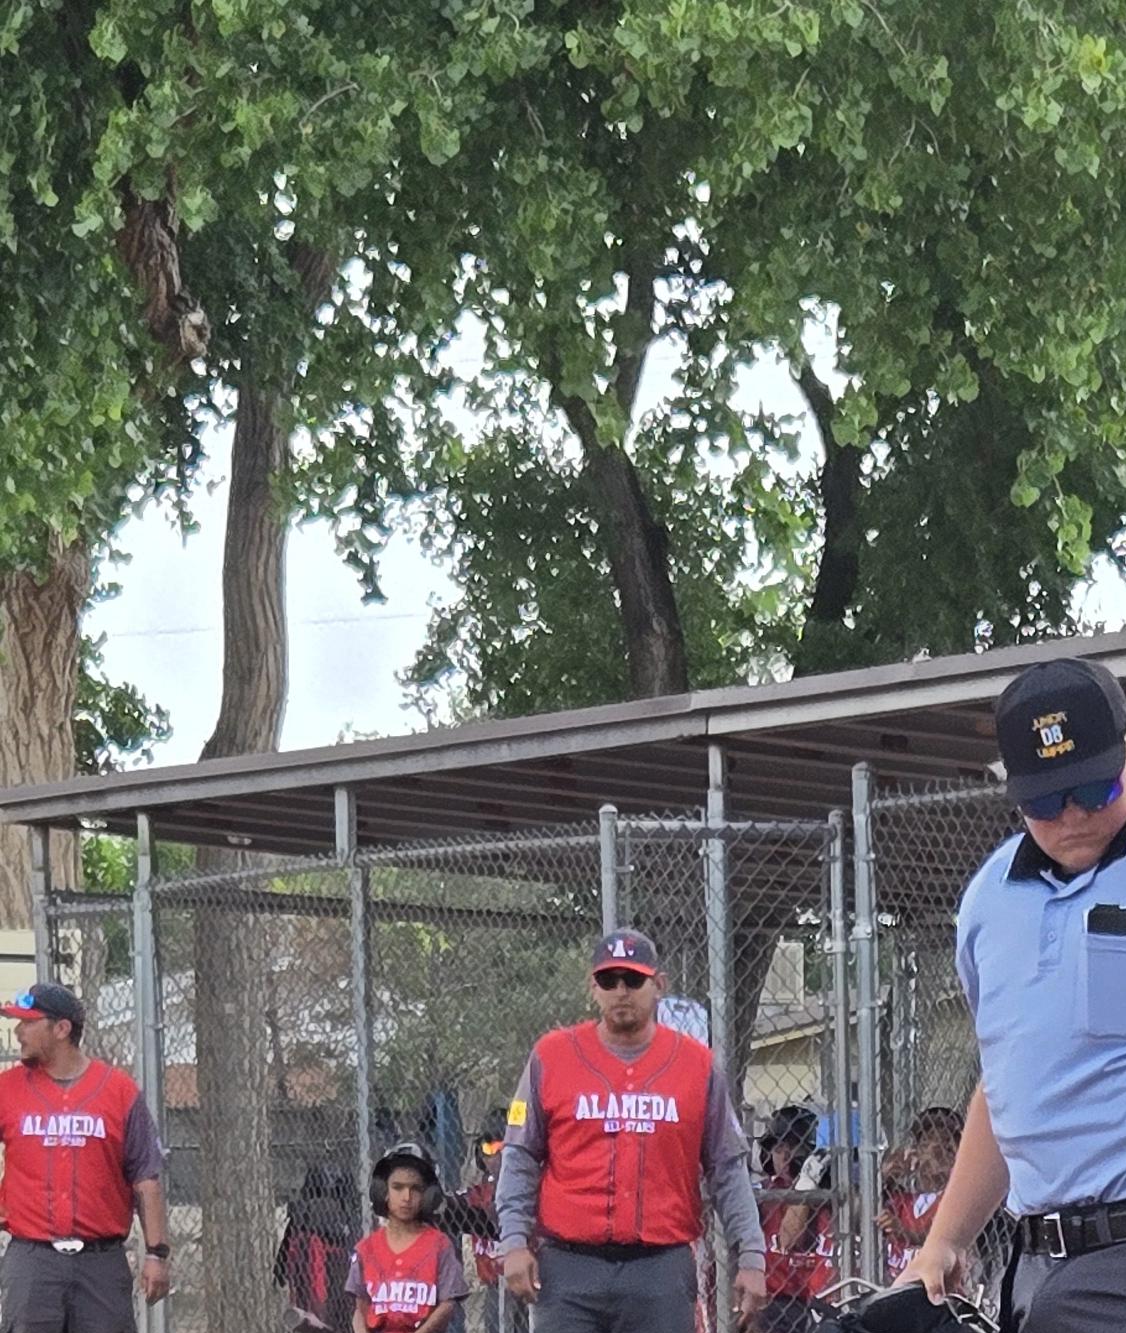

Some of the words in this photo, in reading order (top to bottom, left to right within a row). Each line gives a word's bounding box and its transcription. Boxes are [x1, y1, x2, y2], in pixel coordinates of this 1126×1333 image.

[576, 1092, 680, 1123] ALAMEDA
[22, 1115, 106, 1139] ALAMEDA
[366, 1280, 437, 1307] LAMEDA
